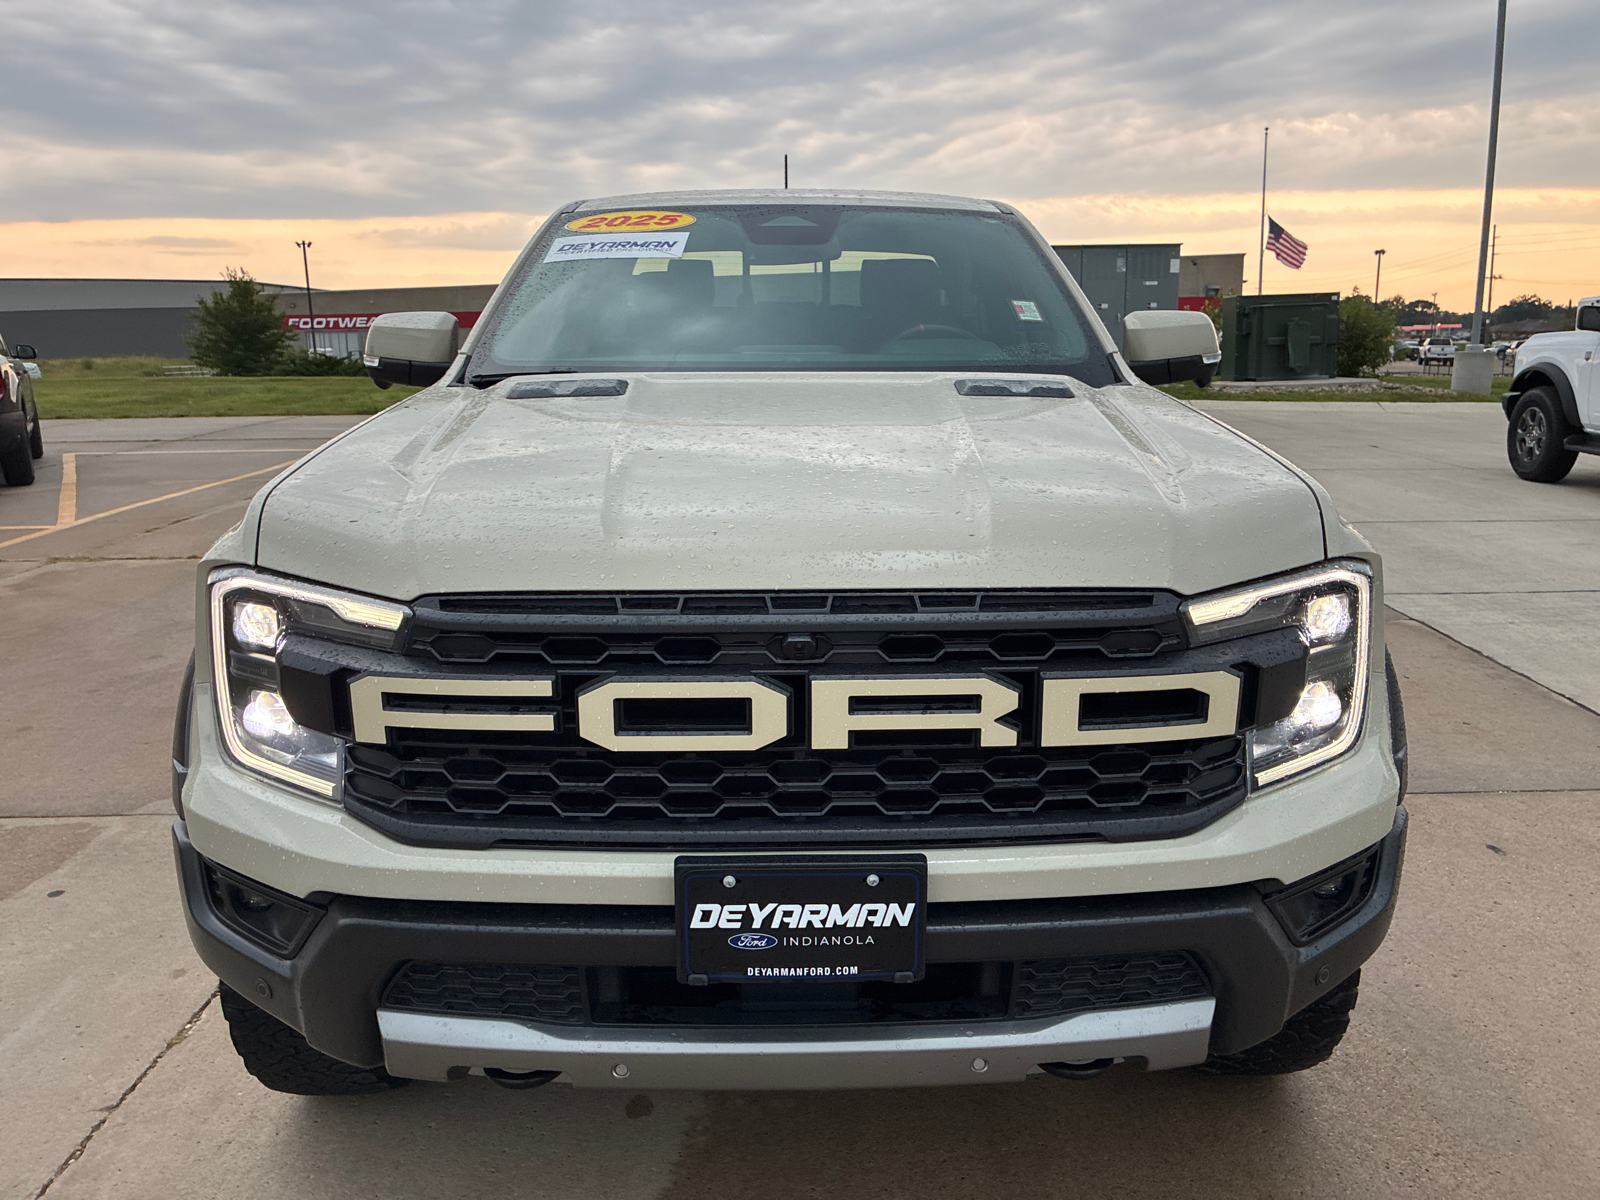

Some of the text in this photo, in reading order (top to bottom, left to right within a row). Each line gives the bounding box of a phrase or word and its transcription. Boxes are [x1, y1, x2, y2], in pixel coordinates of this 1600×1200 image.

[578, 214, 683, 229] 2025
[557, 241, 678, 252] DEYARMAN
[350, 670, 1240, 751] FORD
[689, 903, 916, 929] DEYARMAN
[737, 934, 875, 947] Ford INDIANOLA
[747, 966, 859, 977] DEYARMANFORD.COM
